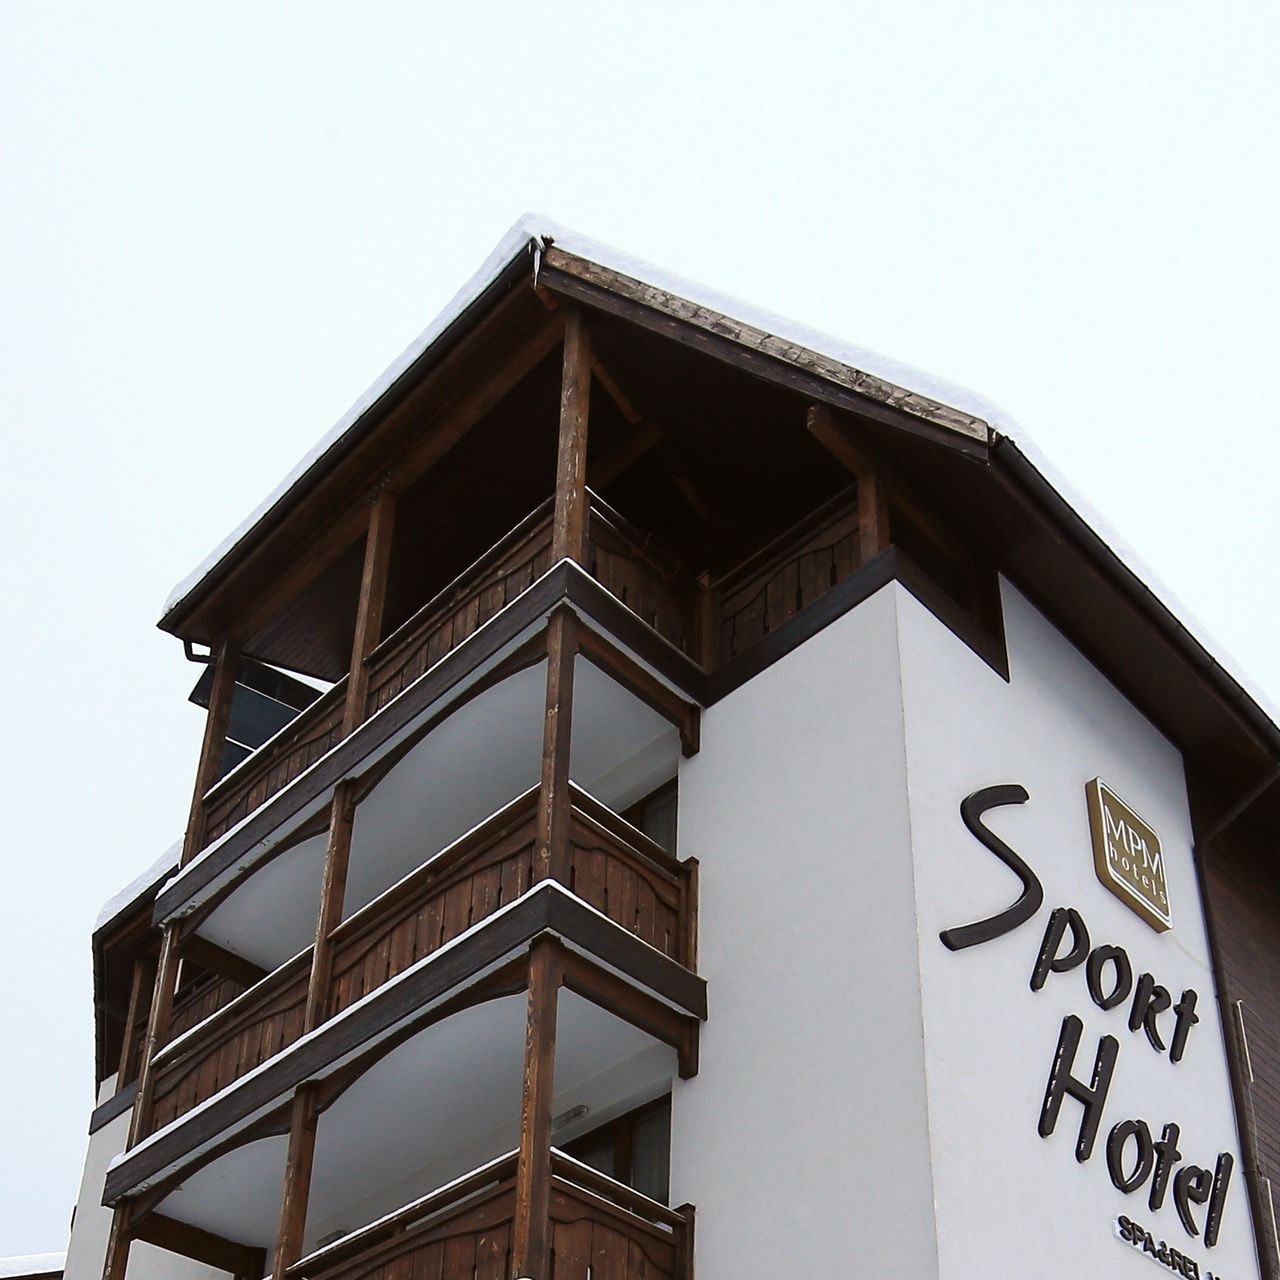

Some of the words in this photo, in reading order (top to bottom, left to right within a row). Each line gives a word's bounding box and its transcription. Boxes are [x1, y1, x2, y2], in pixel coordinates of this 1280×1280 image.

[1104, 804, 1164, 883] MPM
[1108, 840, 1167, 905] hotels
[1036, 1014, 1234, 1249] Hotel
